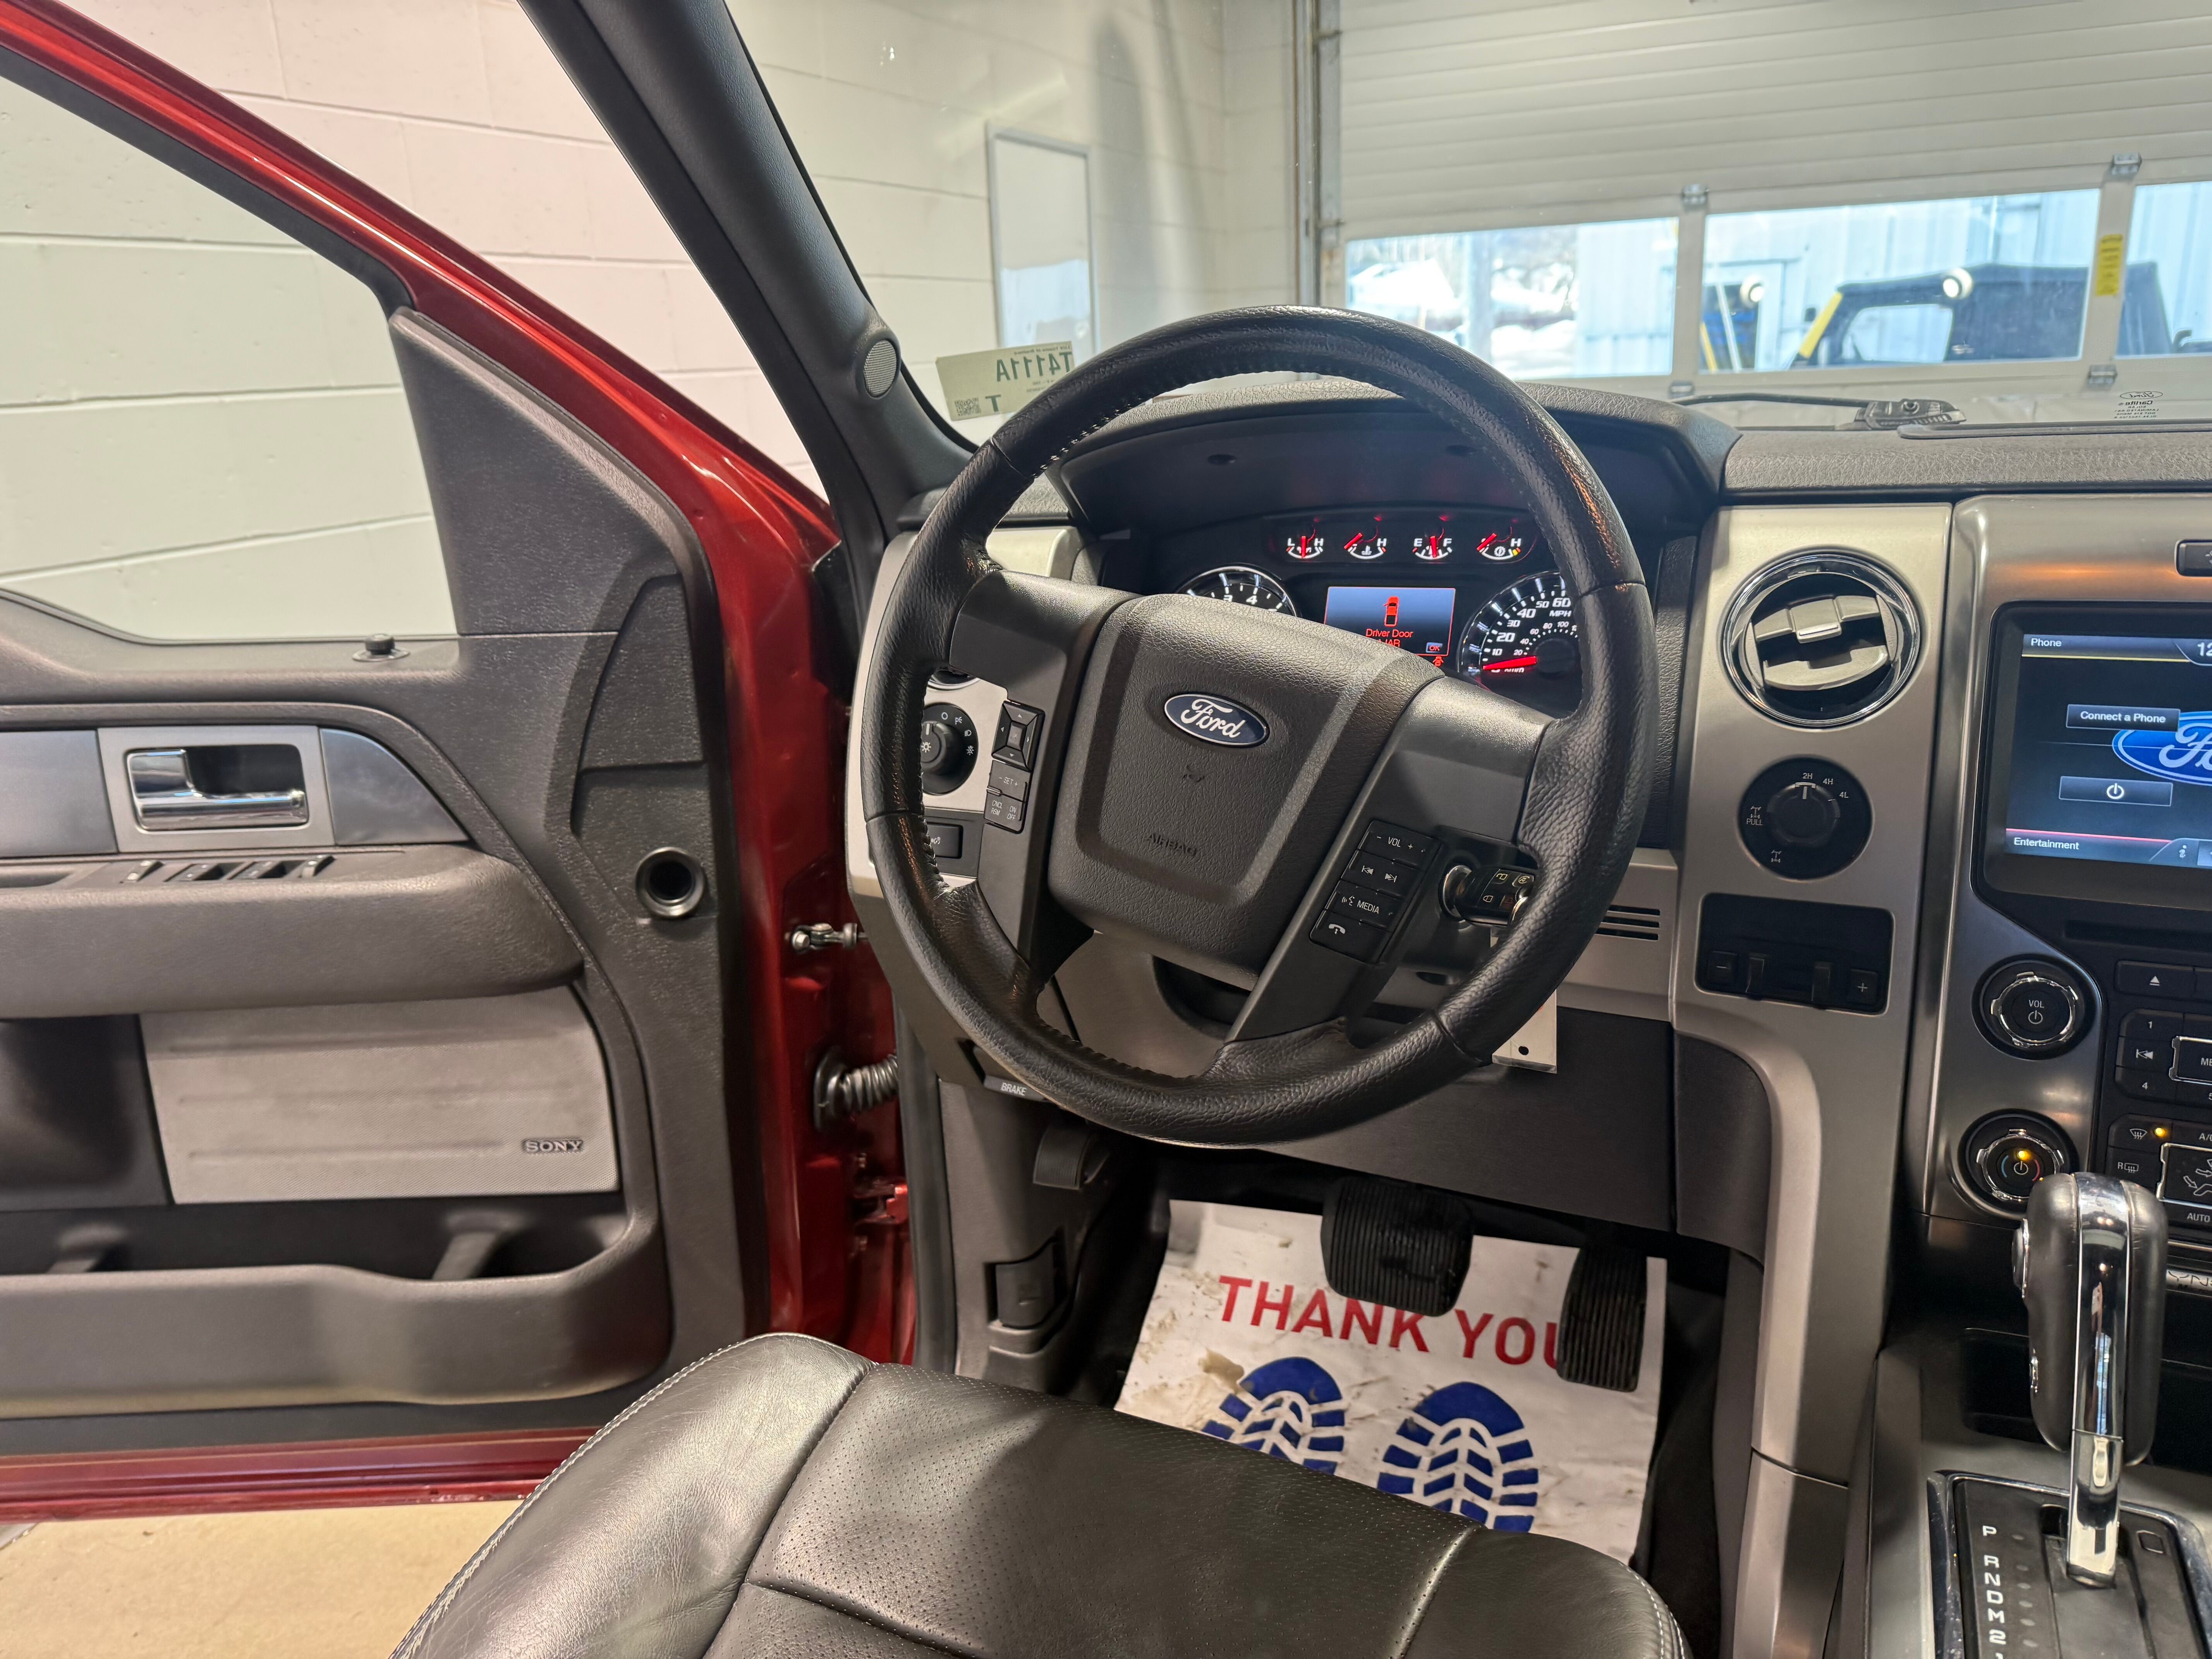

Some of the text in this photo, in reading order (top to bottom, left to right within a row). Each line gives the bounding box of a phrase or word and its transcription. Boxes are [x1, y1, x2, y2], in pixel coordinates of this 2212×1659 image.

[1288, 538, 1295, 546] L
[1314, 538, 1324, 546] H
[1377, 538, 1387, 546] H
[1414, 538, 1422, 547] E
[1443, 538, 1452, 547] F
[1511, 538, 1521, 547] H
[1246, 595, 1258, 605] 4
[1552, 598, 1571, 607] 60
[1517, 608, 1536, 618] 40
[1366, 629, 1413, 637] Driver Door
[1496, 632, 1515, 642] 20
[2031, 638, 2062, 647] Phone
[1180, 699, 1246, 738] Ford
[2080, 711, 2122, 722] Connect
[2133, 714, 2166, 724] Phone
[1004, 777, 1014, 785] SET
[1388, 837, 1401, 847] VOL
[2014, 837, 2080, 850] Entertainment
[1357, 900, 1379, 914] MEDIA
[2028, 1000, 2045, 1008] VOL
[1000, 1082, 1027, 1096] BRAKE
[526, 1140, 582, 1152] SONY
[2187, 1212, 2210, 1223] AUTO
[1219, 1275, 1429, 1352] THANK
[1982, 1525, 1997, 1536] P
[1984, 1555, 1999, 1568] R
[1985, 1572, 2001, 1586] N
[1987, 1590, 2003, 1604] D
[1988, 1608, 2005, 1623] M
[1989, 1629, 2006, 1645] 2
